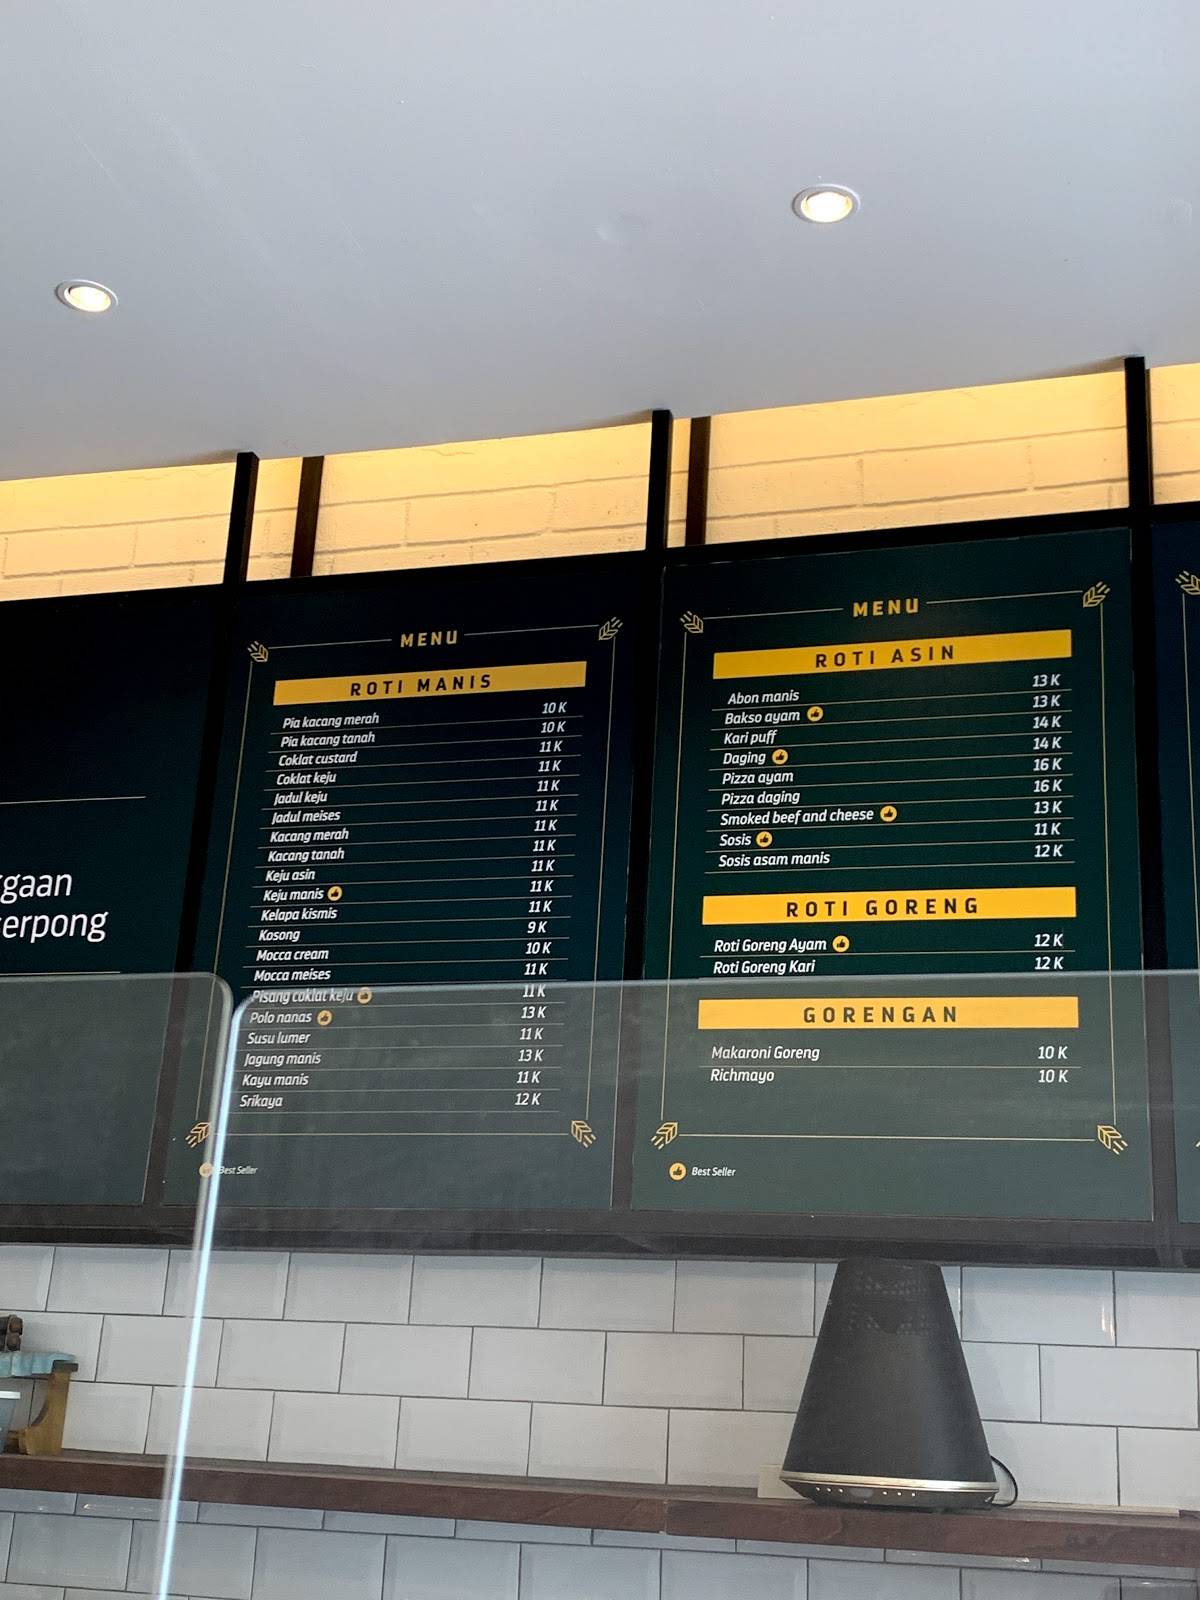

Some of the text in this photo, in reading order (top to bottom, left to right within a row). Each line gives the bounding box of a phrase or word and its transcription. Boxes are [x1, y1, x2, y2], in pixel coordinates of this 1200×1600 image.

[853, 598, 919, 617] MENU
[400, 630, 459, 648] MENU
[816, 645, 955, 668] ROTI ASIN
[350, 674, 492, 696] ROTI MANIS
[728, 674, 1060, 705] Abon manis 13 K
[282, 702, 567, 729] Pia kacang merah 10 K
[724, 695, 1061, 725] Bakso ayam 13 K
[280, 721, 565, 748] Pia kacang tanah 10 K
[724, 716, 1061, 747] Kari puff 14 K
[278, 740, 563, 767] Coklat custard 11 K
[722, 736, 1062, 767] Daging 14 K
[276, 760, 561, 786] Coklat keju 11 K
[722, 758, 1062, 786] Pizza ayam 16 K
[273, 780, 560, 806] Jadul keju 11 K
[721, 779, 1062, 805] Pizza daging 16 K
[271, 800, 559, 825] Jadul meises 11 K
[720, 801, 1062, 826] Smoked beef and cheese 13 K
[270, 820, 558, 844] Kacang merah 11 K
[719, 822, 1061, 847] Sosis 11 K
[268, 840, 556, 864] Kacang tanah 11 K
[718, 844, 1063, 867] Sosis asam manis 12 K
[265, 860, 555, 884] Keju asin 11 K
[0, 872, 72, 904] gaan
[263, 880, 554, 904] Keju manis 11 K
[261, 901, 552, 924] Kelapa kismis 11 K
[786, 897, 979, 918] ROTI GORENG
[0, 911, 109, 943] erpong
[258, 921, 547, 943] Kosong 9 K
[256, 942, 552, 962] Mocca cream 10 K
[714, 933, 1063, 954] Roti Goreng Ayam 12 K
[253, 963, 548, 982] Mocca meises 11 K
[713, 956, 1064, 976] Roti Goreng Kari 12 K
[251, 985, 547, 1005] Pisang coklat keju 11 K
[249, 1006, 546, 1024] Polo nanas 13 K
[803, 1005, 959, 1024] GORENGAN
[246, 1028, 543, 1045] Susu lumer 11 K
[243, 1049, 543, 1068] Jagung manis 13 K
[711, 1045, 1068, 1062] Makaroni Goreng 10 K
[242, 1071, 541, 1089] Kayu manis 11 K
[710, 1068, 1069, 1084] Richmayo 10 K
[240, 1093, 541, 1110] Srikaya 12 K
[236, 1166, 257, 1175] Seller
[691, 1166, 736, 1177] Best Seller
